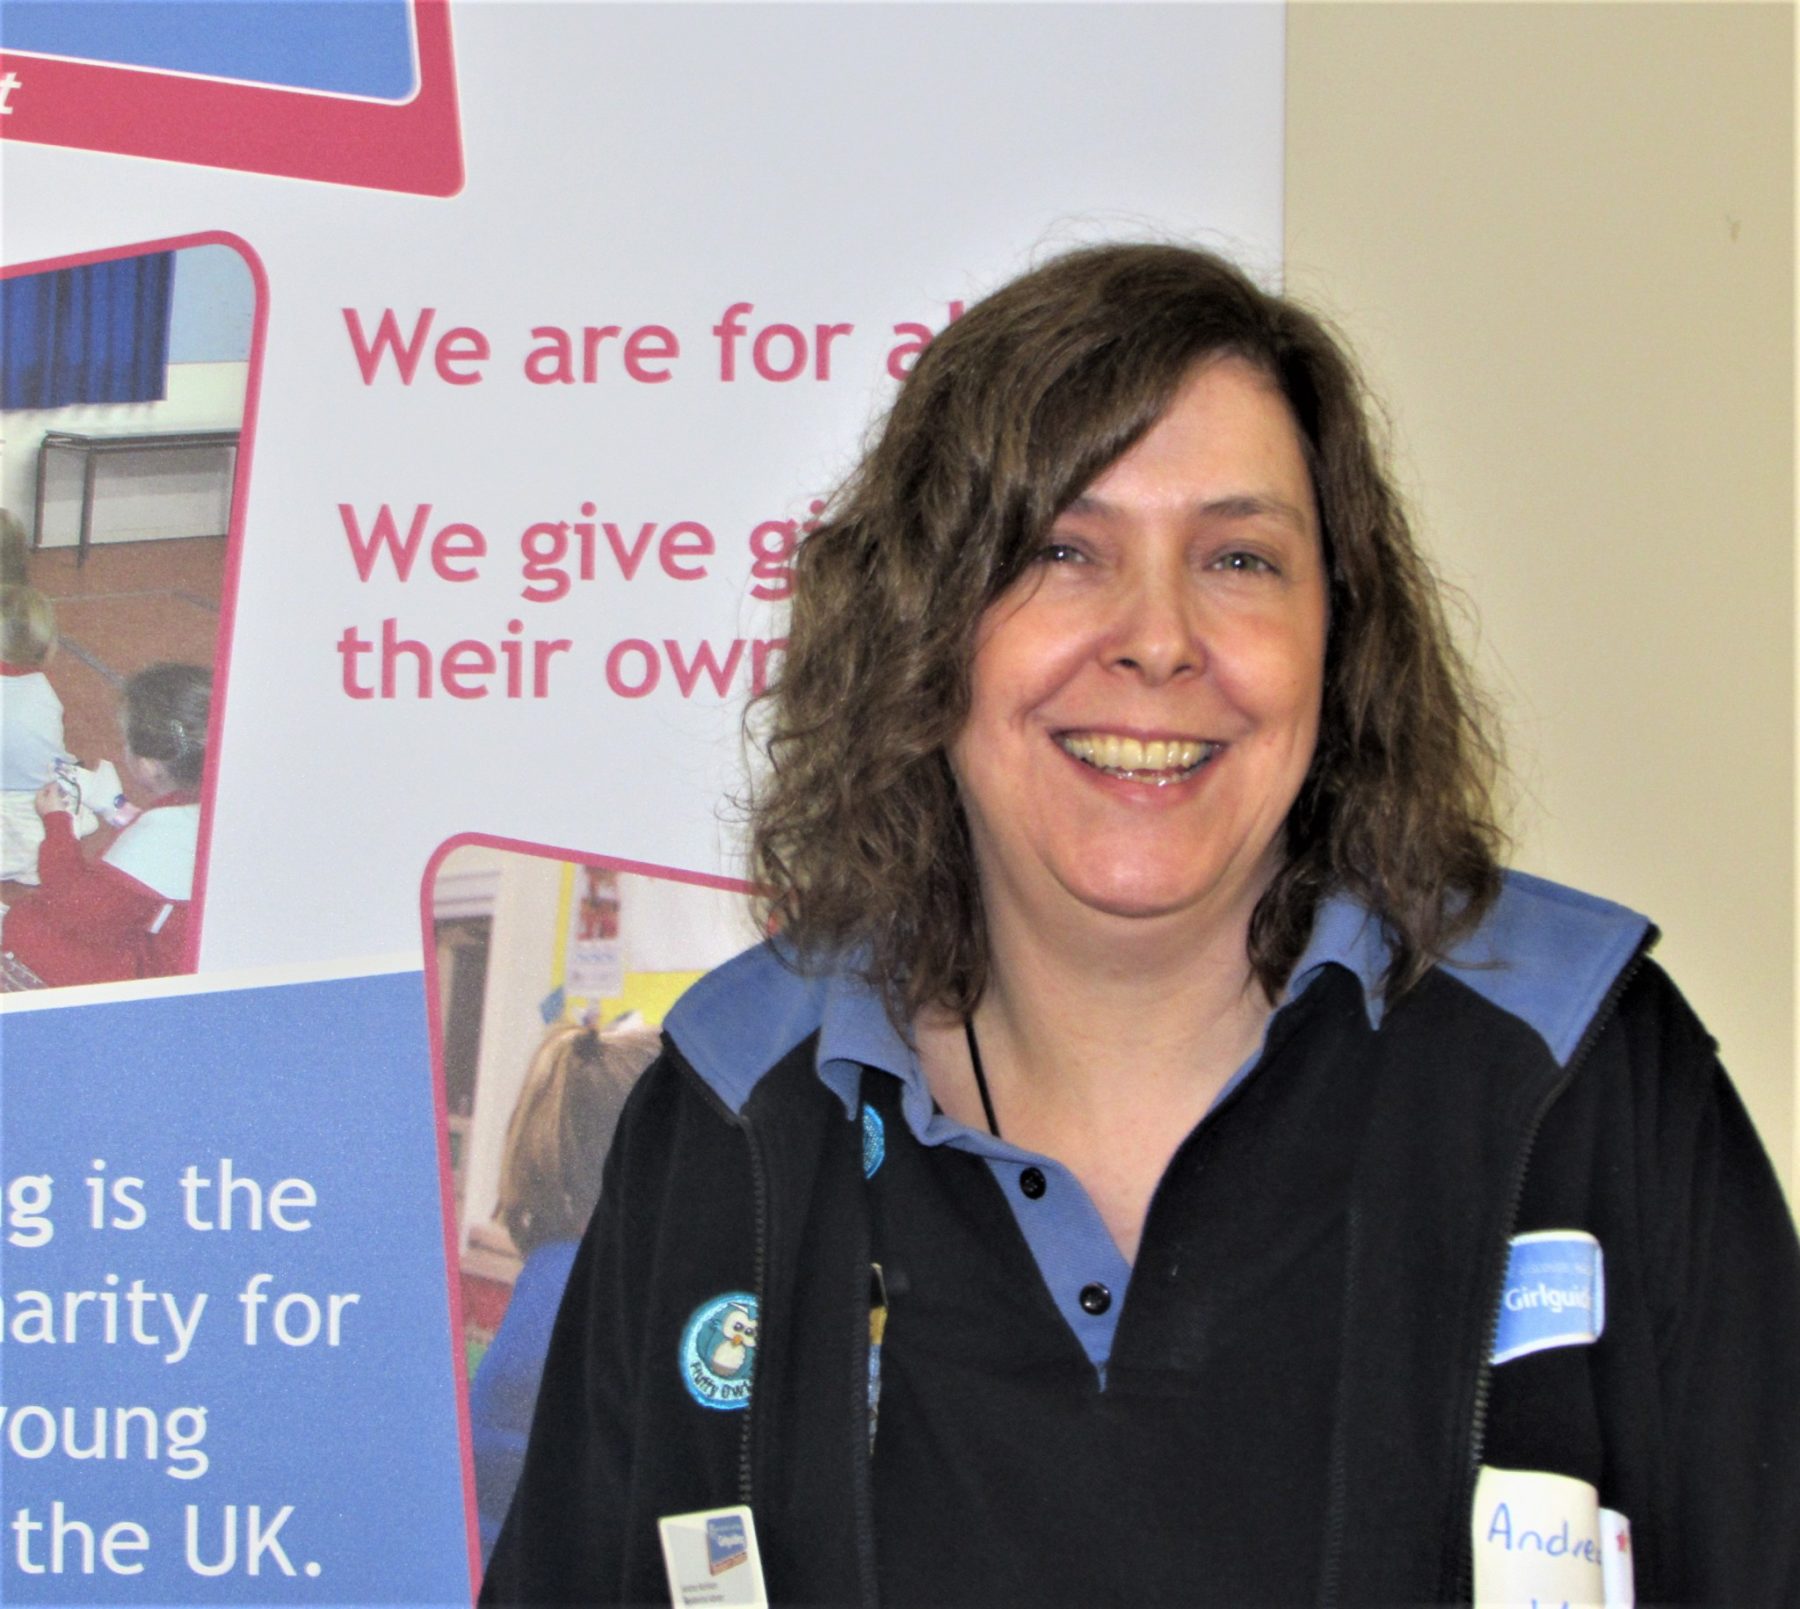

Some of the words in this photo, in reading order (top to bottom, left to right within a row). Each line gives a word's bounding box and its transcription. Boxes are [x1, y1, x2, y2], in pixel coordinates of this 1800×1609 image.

[341, 308, 491, 386] We
[524, 325, 680, 385] are
[712, 302, 854, 383] for
[886, 300, 965, 384] a
[338, 503, 487, 582] We
[520, 502, 716, 603] give
[749, 500, 826, 601] g
[337, 618, 572, 699] their
[85, 1158, 147, 1231] is
[179, 1158, 317, 1232] the
[0, 1273, 208, 1364] arity
[238, 1273, 361, 1347] for
[11, 1501, 150, 1575] the
[185, 1504, 322, 1578] UK.
